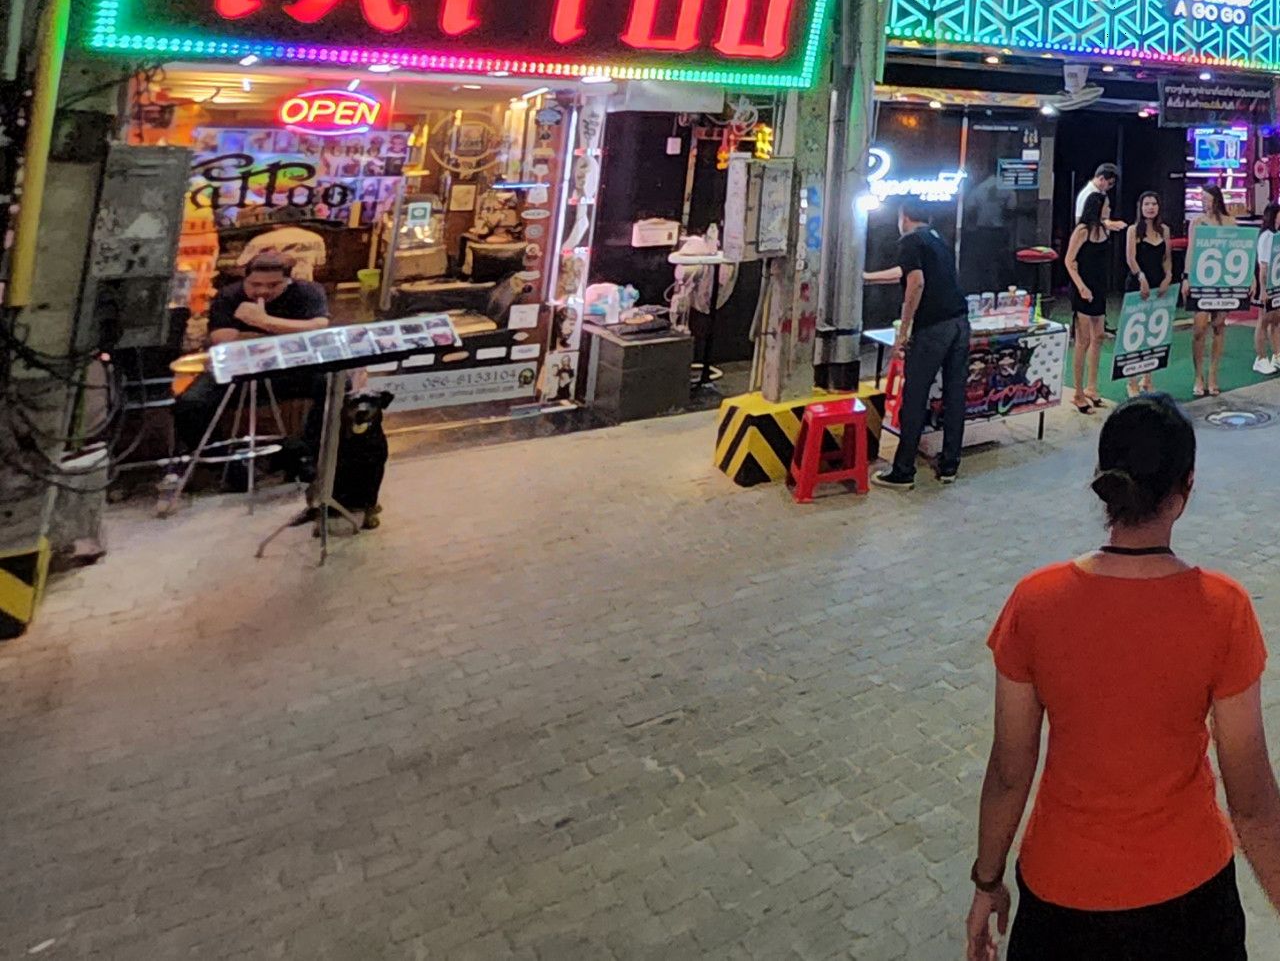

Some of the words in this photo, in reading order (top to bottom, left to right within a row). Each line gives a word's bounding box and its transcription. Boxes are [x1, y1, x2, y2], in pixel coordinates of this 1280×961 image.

[1174, 1, 1188, 17] A
[281, 98, 381, 125] OPEN
[1196, 248, 1249, 286] 69
[1123, 308, 1169, 352] 69
